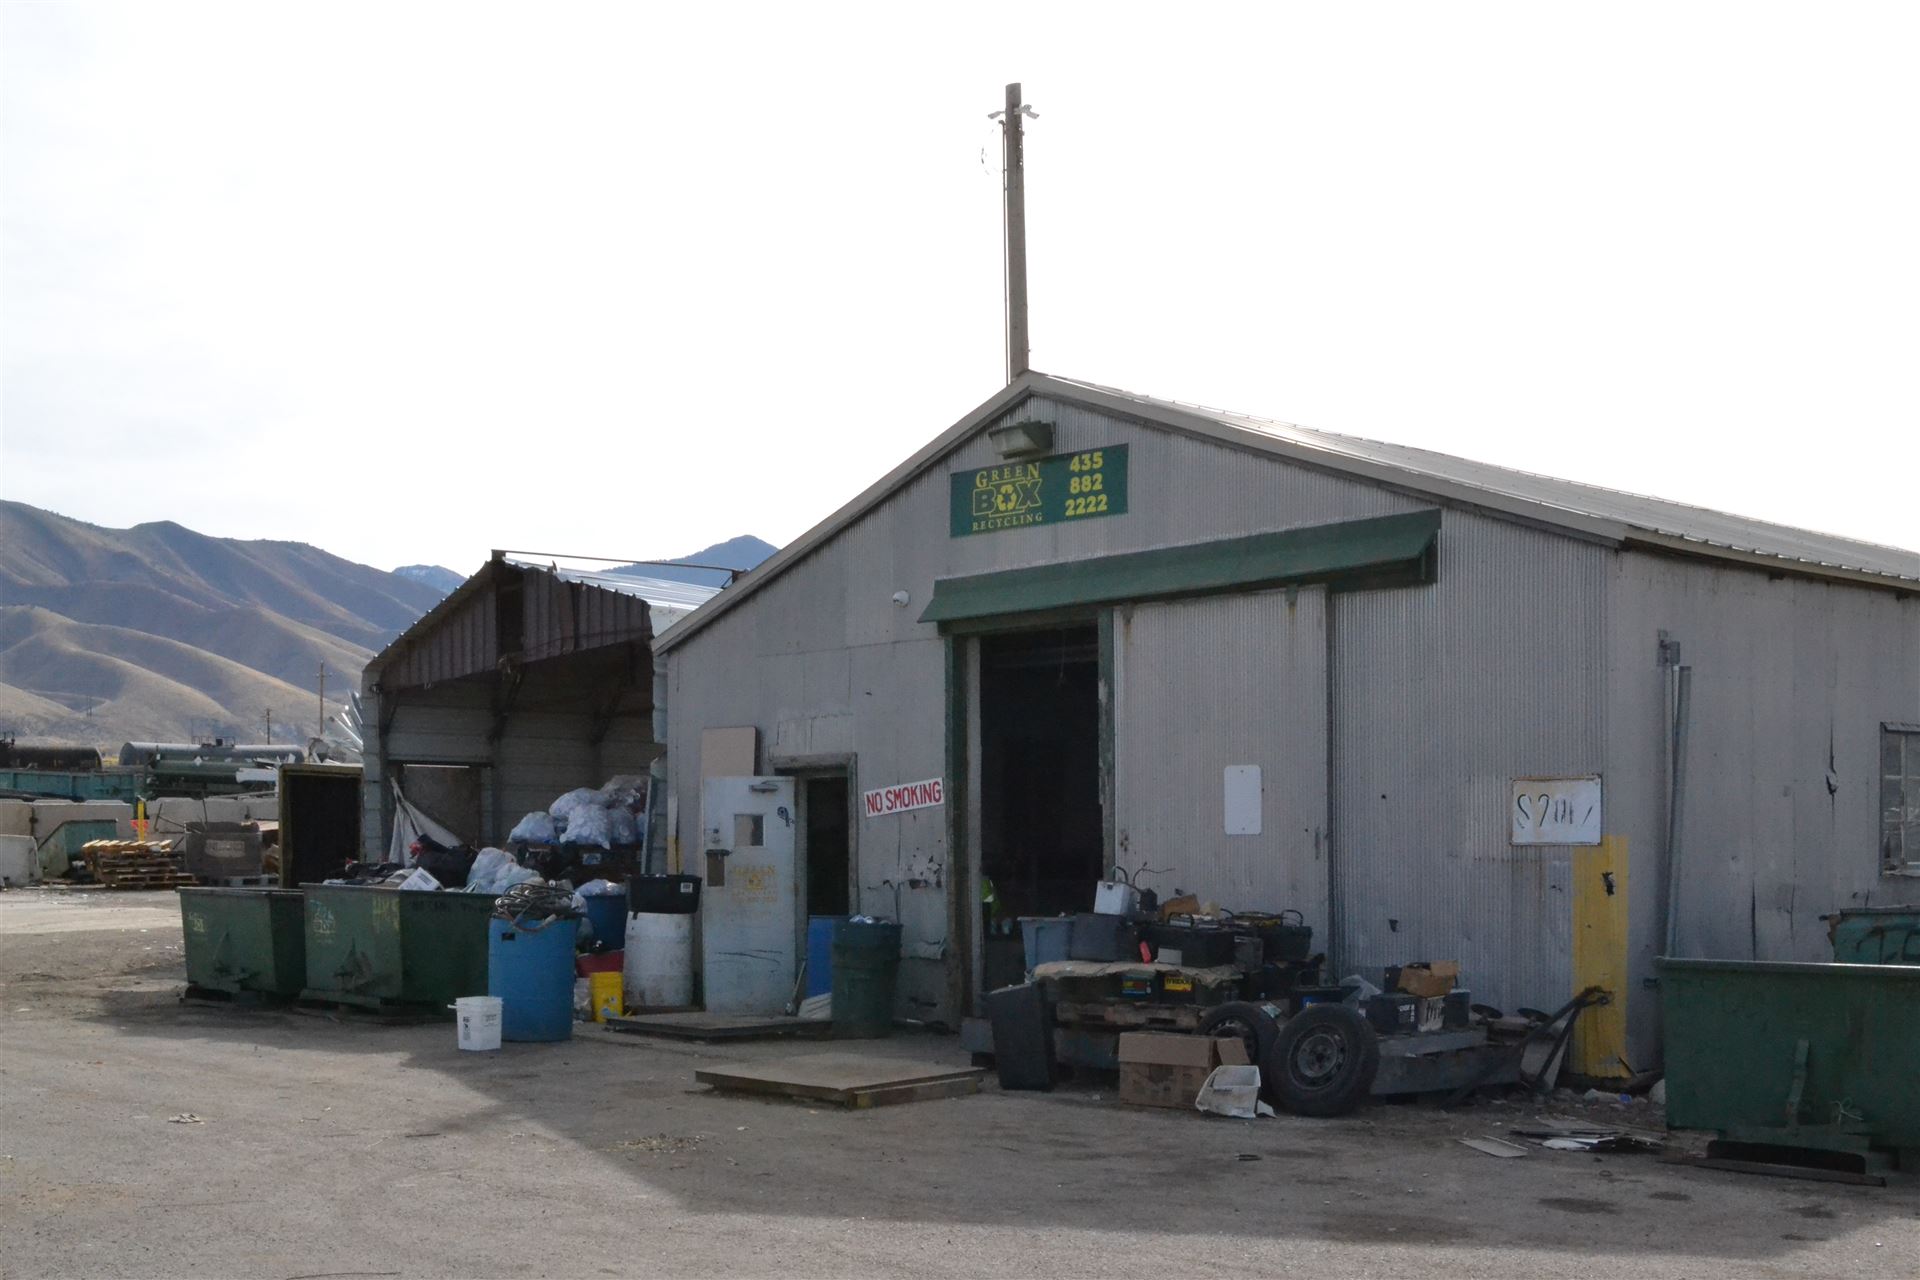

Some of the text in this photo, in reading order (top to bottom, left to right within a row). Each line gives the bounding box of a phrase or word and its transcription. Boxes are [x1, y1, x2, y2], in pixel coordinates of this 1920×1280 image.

[1070, 452, 1103, 472] 435
[975, 462, 1040, 488] GREEN
[1070, 473, 1103, 494] 882
[973, 478, 1042, 517] BOX
[1065, 494, 1108, 516] 2222
[972, 512, 1043, 531] RECYCLING
[866, 780, 942, 814] NO SMOKING
